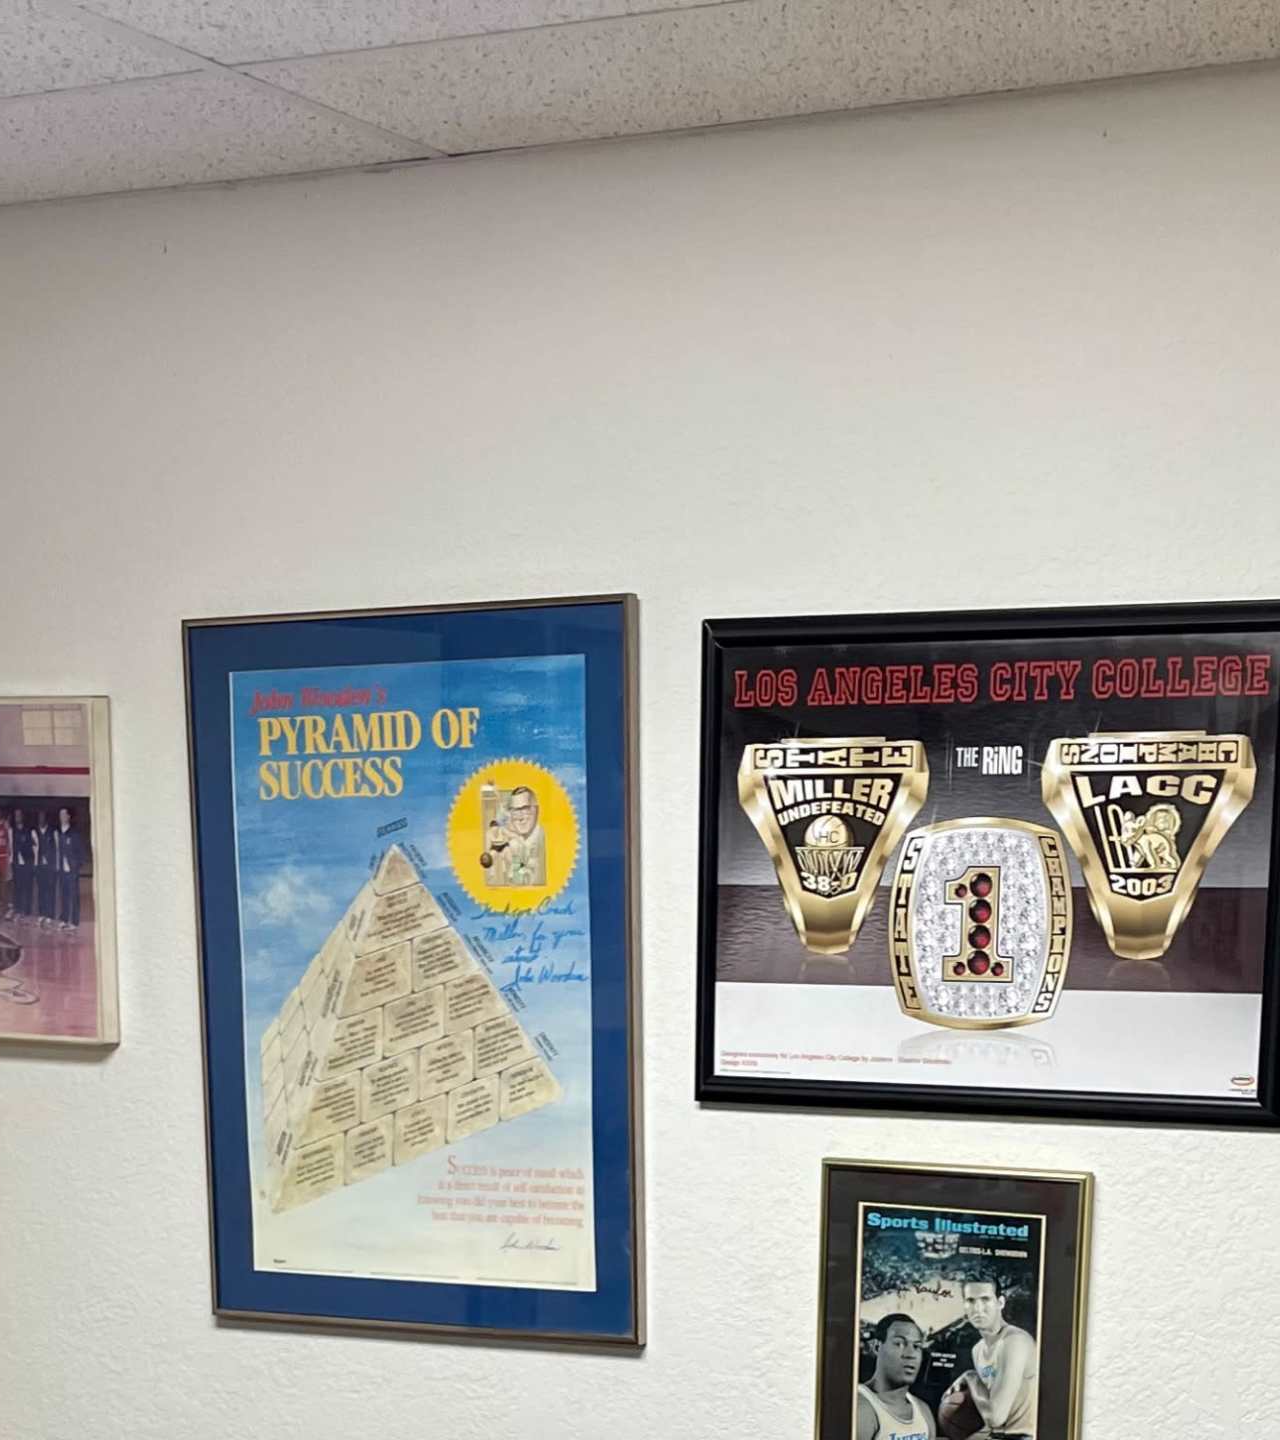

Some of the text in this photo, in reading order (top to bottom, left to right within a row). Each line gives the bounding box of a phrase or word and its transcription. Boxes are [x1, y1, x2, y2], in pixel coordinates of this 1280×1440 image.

[734, 655, 1271, 708] LOS ANGELES CITY COLLEGE
[257, 707, 480, 756] PYRAMID OF
[956, 747, 979, 768] THE
[259, 756, 404, 801] SUCCESS
[770, 778, 894, 810] MILLER
[1075, 774, 1217, 808] LACC
[777, 801, 886, 826] UNDEFEATED
[816, 830, 840, 844] HC
[1109, 874, 1175, 896] 2003
[943, 866, 1014, 982] 1
[867, 1212, 1029, 1238] Sports Illustrated
